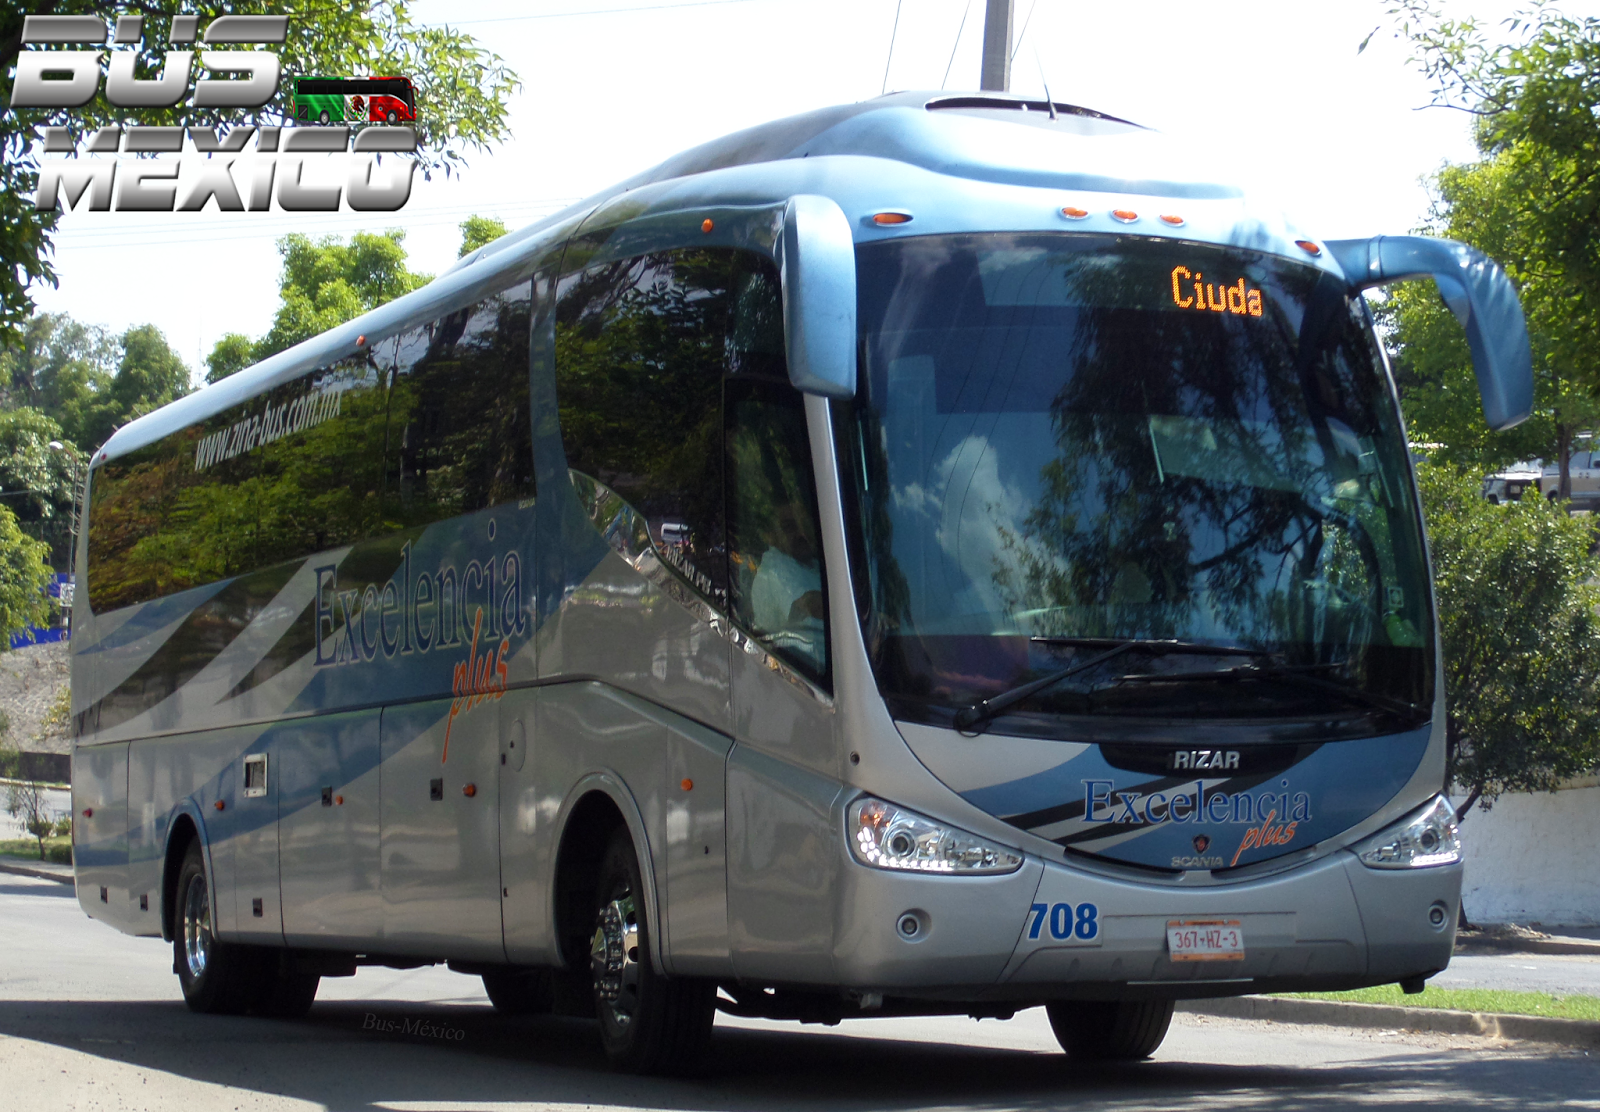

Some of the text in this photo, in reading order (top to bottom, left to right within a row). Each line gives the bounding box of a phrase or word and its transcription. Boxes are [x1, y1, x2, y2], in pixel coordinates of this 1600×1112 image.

[1171, 265, 1263, 317] Ciuda
[195, 388, 341, 471] www.zina-bus.com.mx
[313, 517, 526, 668] Excelencia
[441, 606, 509, 764] plus
[1080, 778, 1313, 824] Excelencia
[1170, 856, 1224, 868] SCANIA
[1230, 808, 1299, 867] plus
[1027, 902, 1099, 941] 708
[1174, 929, 1238, 949] 367-HZ-3
